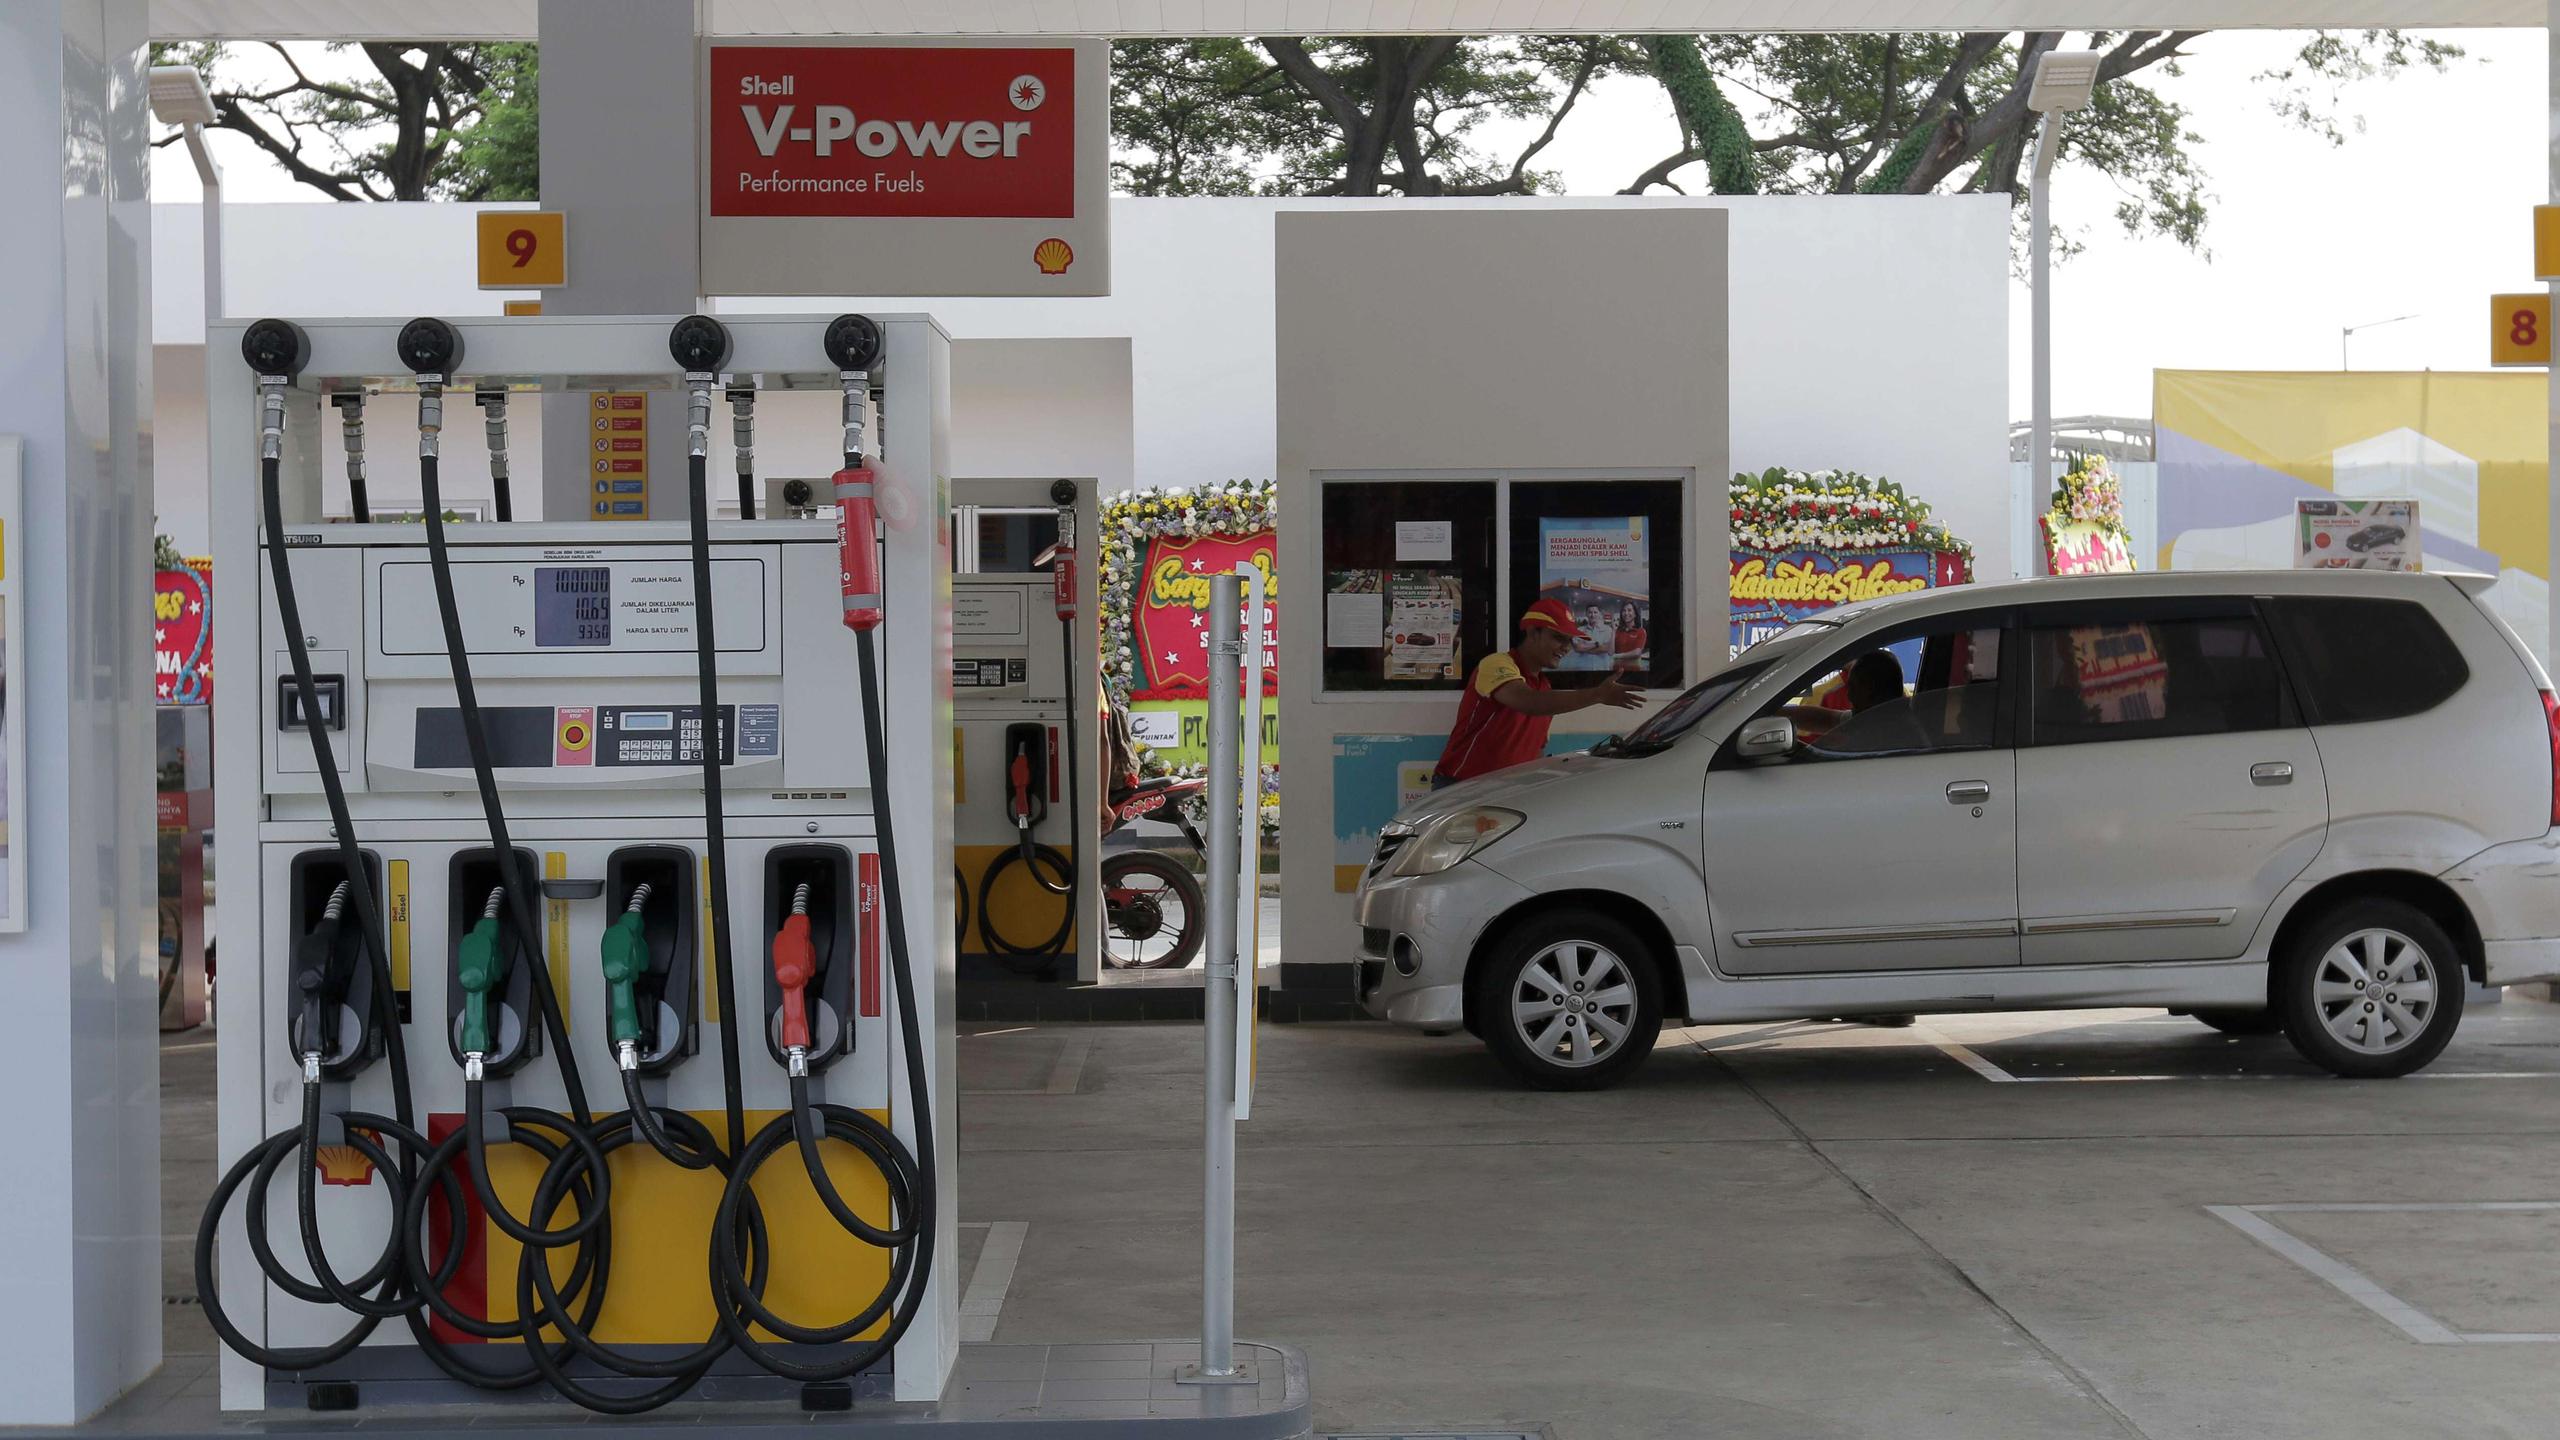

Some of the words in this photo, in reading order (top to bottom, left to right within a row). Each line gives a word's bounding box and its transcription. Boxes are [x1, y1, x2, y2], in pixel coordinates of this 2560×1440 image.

[741, 75, 794, 95] Shell
[740, 104, 1031, 159] V-Power
[740, 170, 867, 193] Performance
[875, 170, 925, 193] Fuels
[506, 229, 537, 268] 9
[2510, 309, 2538, 346] 8
[512, 575, 526, 587] Rp
[555, 569, 610, 593] 100000
[649, 600, 695, 608] DIKELUARKAN
[513, 626, 526, 637] Rp
[578, 624, 609, 639] 9350
[670, 626, 689, 634] LITER
[398, 894, 406, 922] Diesel
